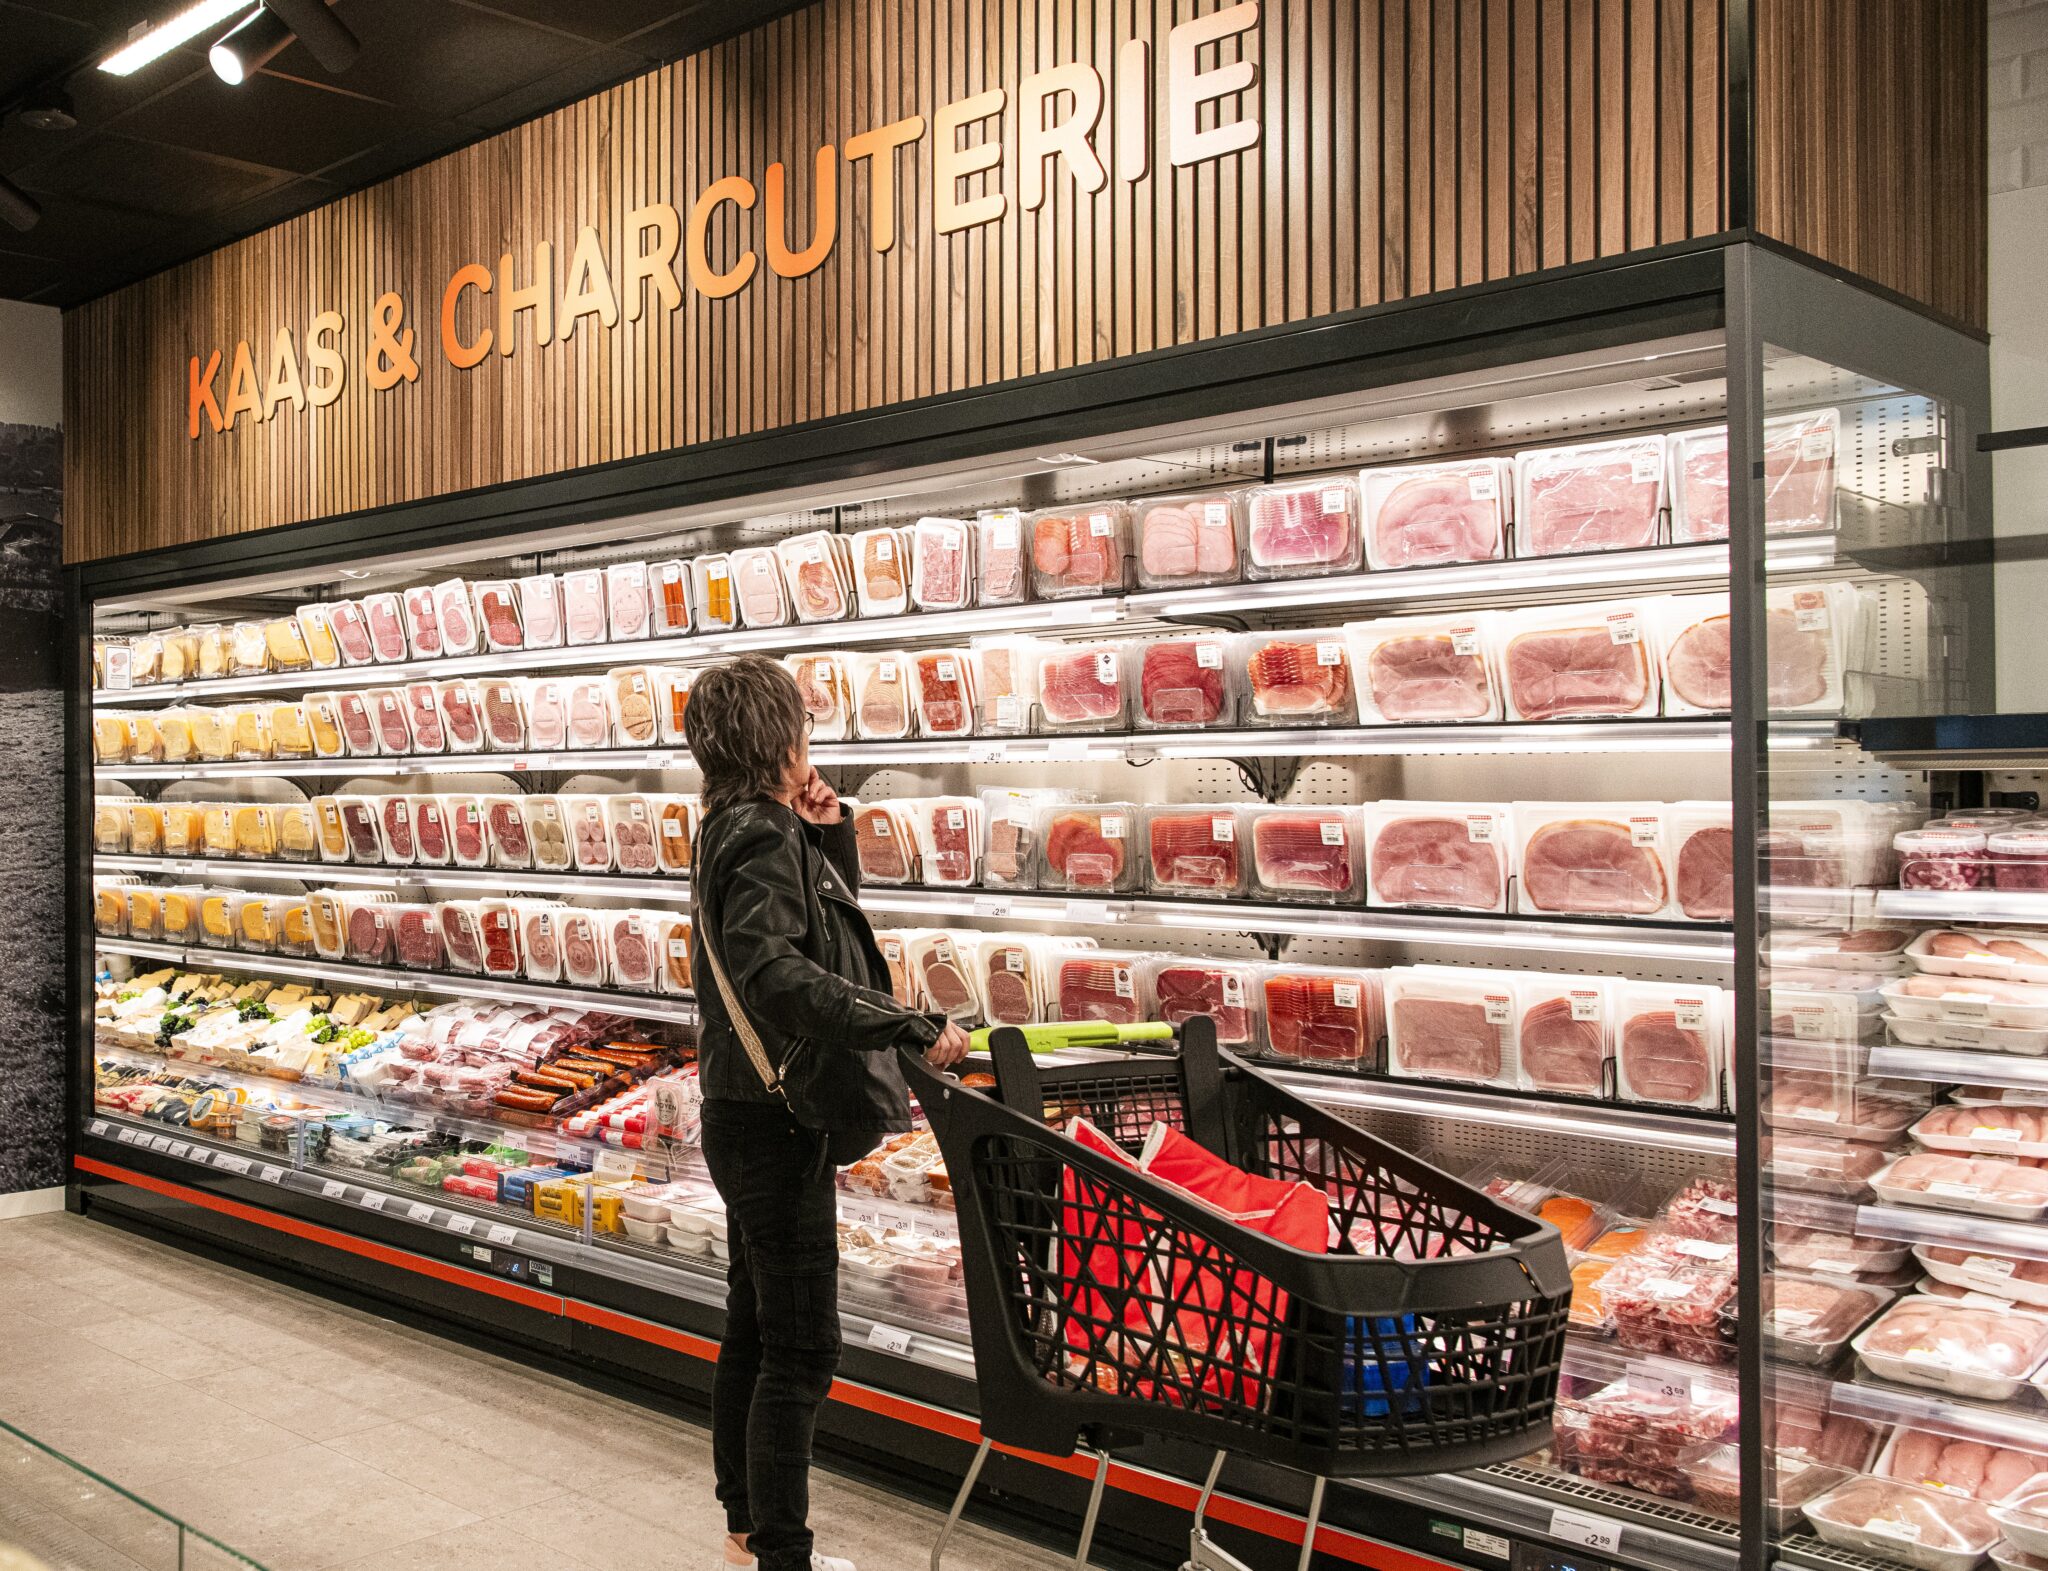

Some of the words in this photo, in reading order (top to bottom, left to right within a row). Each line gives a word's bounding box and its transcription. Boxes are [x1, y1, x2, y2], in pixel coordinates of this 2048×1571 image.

[188, 310, 346, 440] KAAS
[364, 290, 420, 392] &
[440, 1, 1261, 370] CHARCUTERIE
